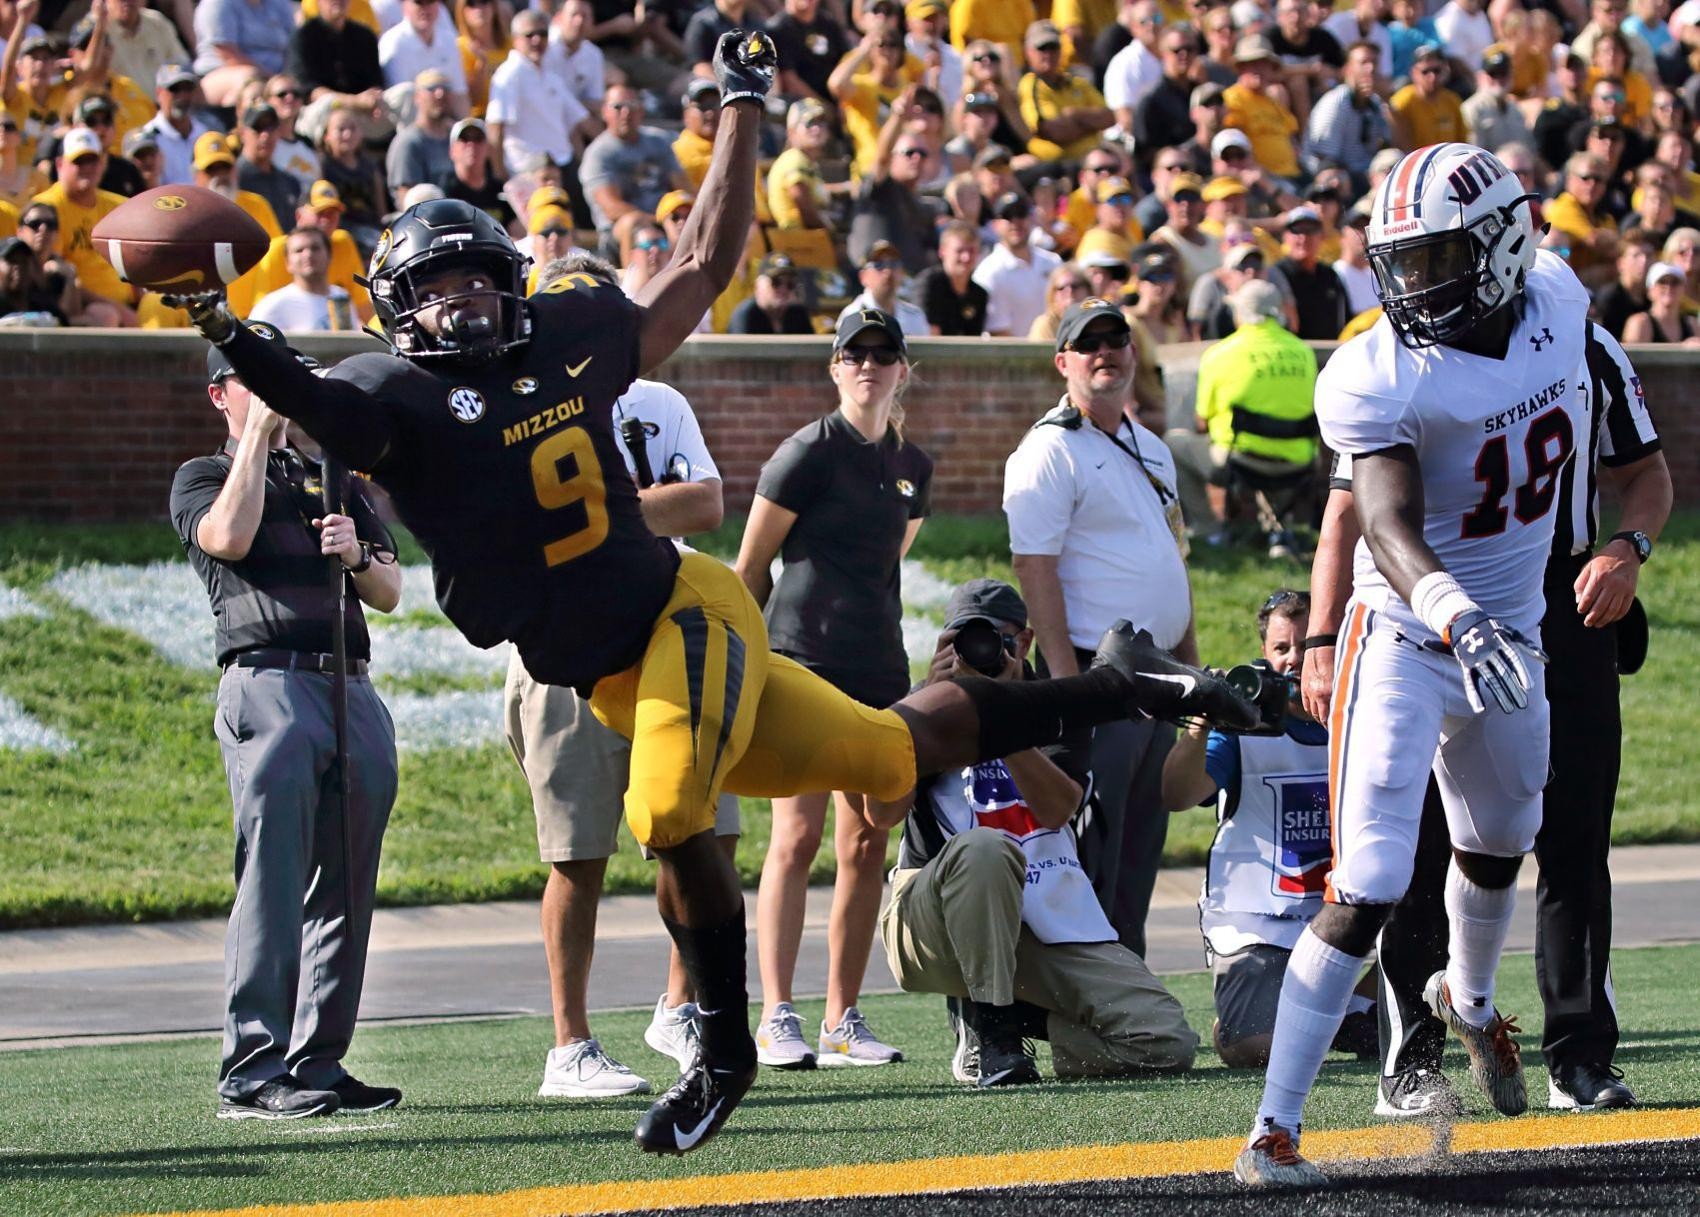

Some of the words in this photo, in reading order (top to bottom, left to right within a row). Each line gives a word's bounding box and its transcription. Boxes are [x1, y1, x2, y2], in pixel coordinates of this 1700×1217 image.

[1383, 221, 1418, 236] Riddell
[450, 389, 483, 421] SEC
[502, 396, 585, 446] MIZZOU
[1485, 378, 1566, 434] SKYHAWKS
[531, 425, 610, 568] 9
[1460, 406, 1574, 540] 18
[1038, 860, 1057, 871] VS.
